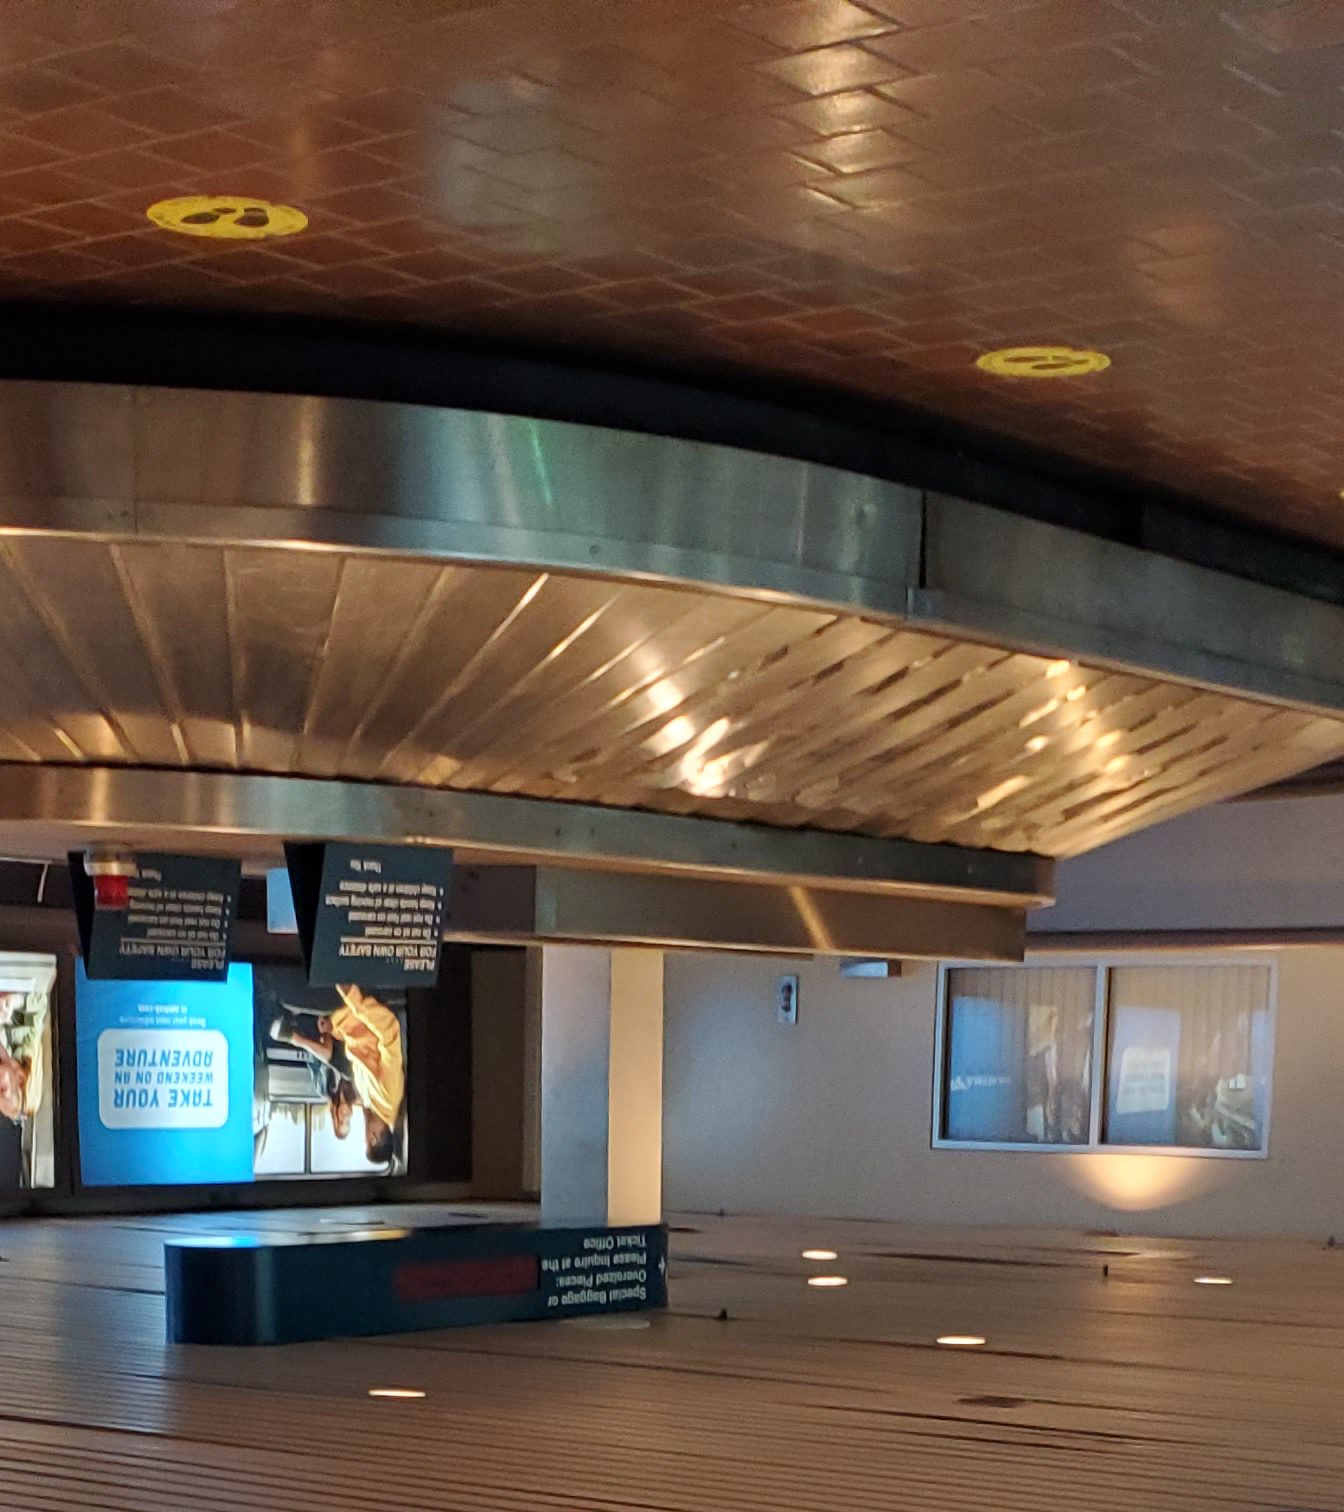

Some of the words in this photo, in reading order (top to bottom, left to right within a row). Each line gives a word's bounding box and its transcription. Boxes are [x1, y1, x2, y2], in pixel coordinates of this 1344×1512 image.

[338, 943, 372, 956] SAFETY
[373, 944, 394, 957] OWN
[396, 945, 418, 957] YOUR
[420, 945, 436, 957] FOR
[114, 1048, 214, 1067] ADVENTURE
[114, 1071, 131, 1084] AN
[135, 1071, 152, 1084] ON
[156, 1071, 214, 1085] WEEKEND
[113, 1088, 160, 1108] YOUR
[167, 1088, 213, 1108] TAKE
[583, 1236, 614, 1251] Office
[616, 1234, 646, 1247] Ticket
[561, 1258, 572, 1271] at
[574, 1252, 610, 1269] Inquire
[613, 1251, 646, 1265] Please
[542, 1258, 559, 1273] the
[596, 1269, 646, 1283] Oversized
[561, 1289, 606, 1304] Baggage
[609, 1285, 646, 1301] Special
